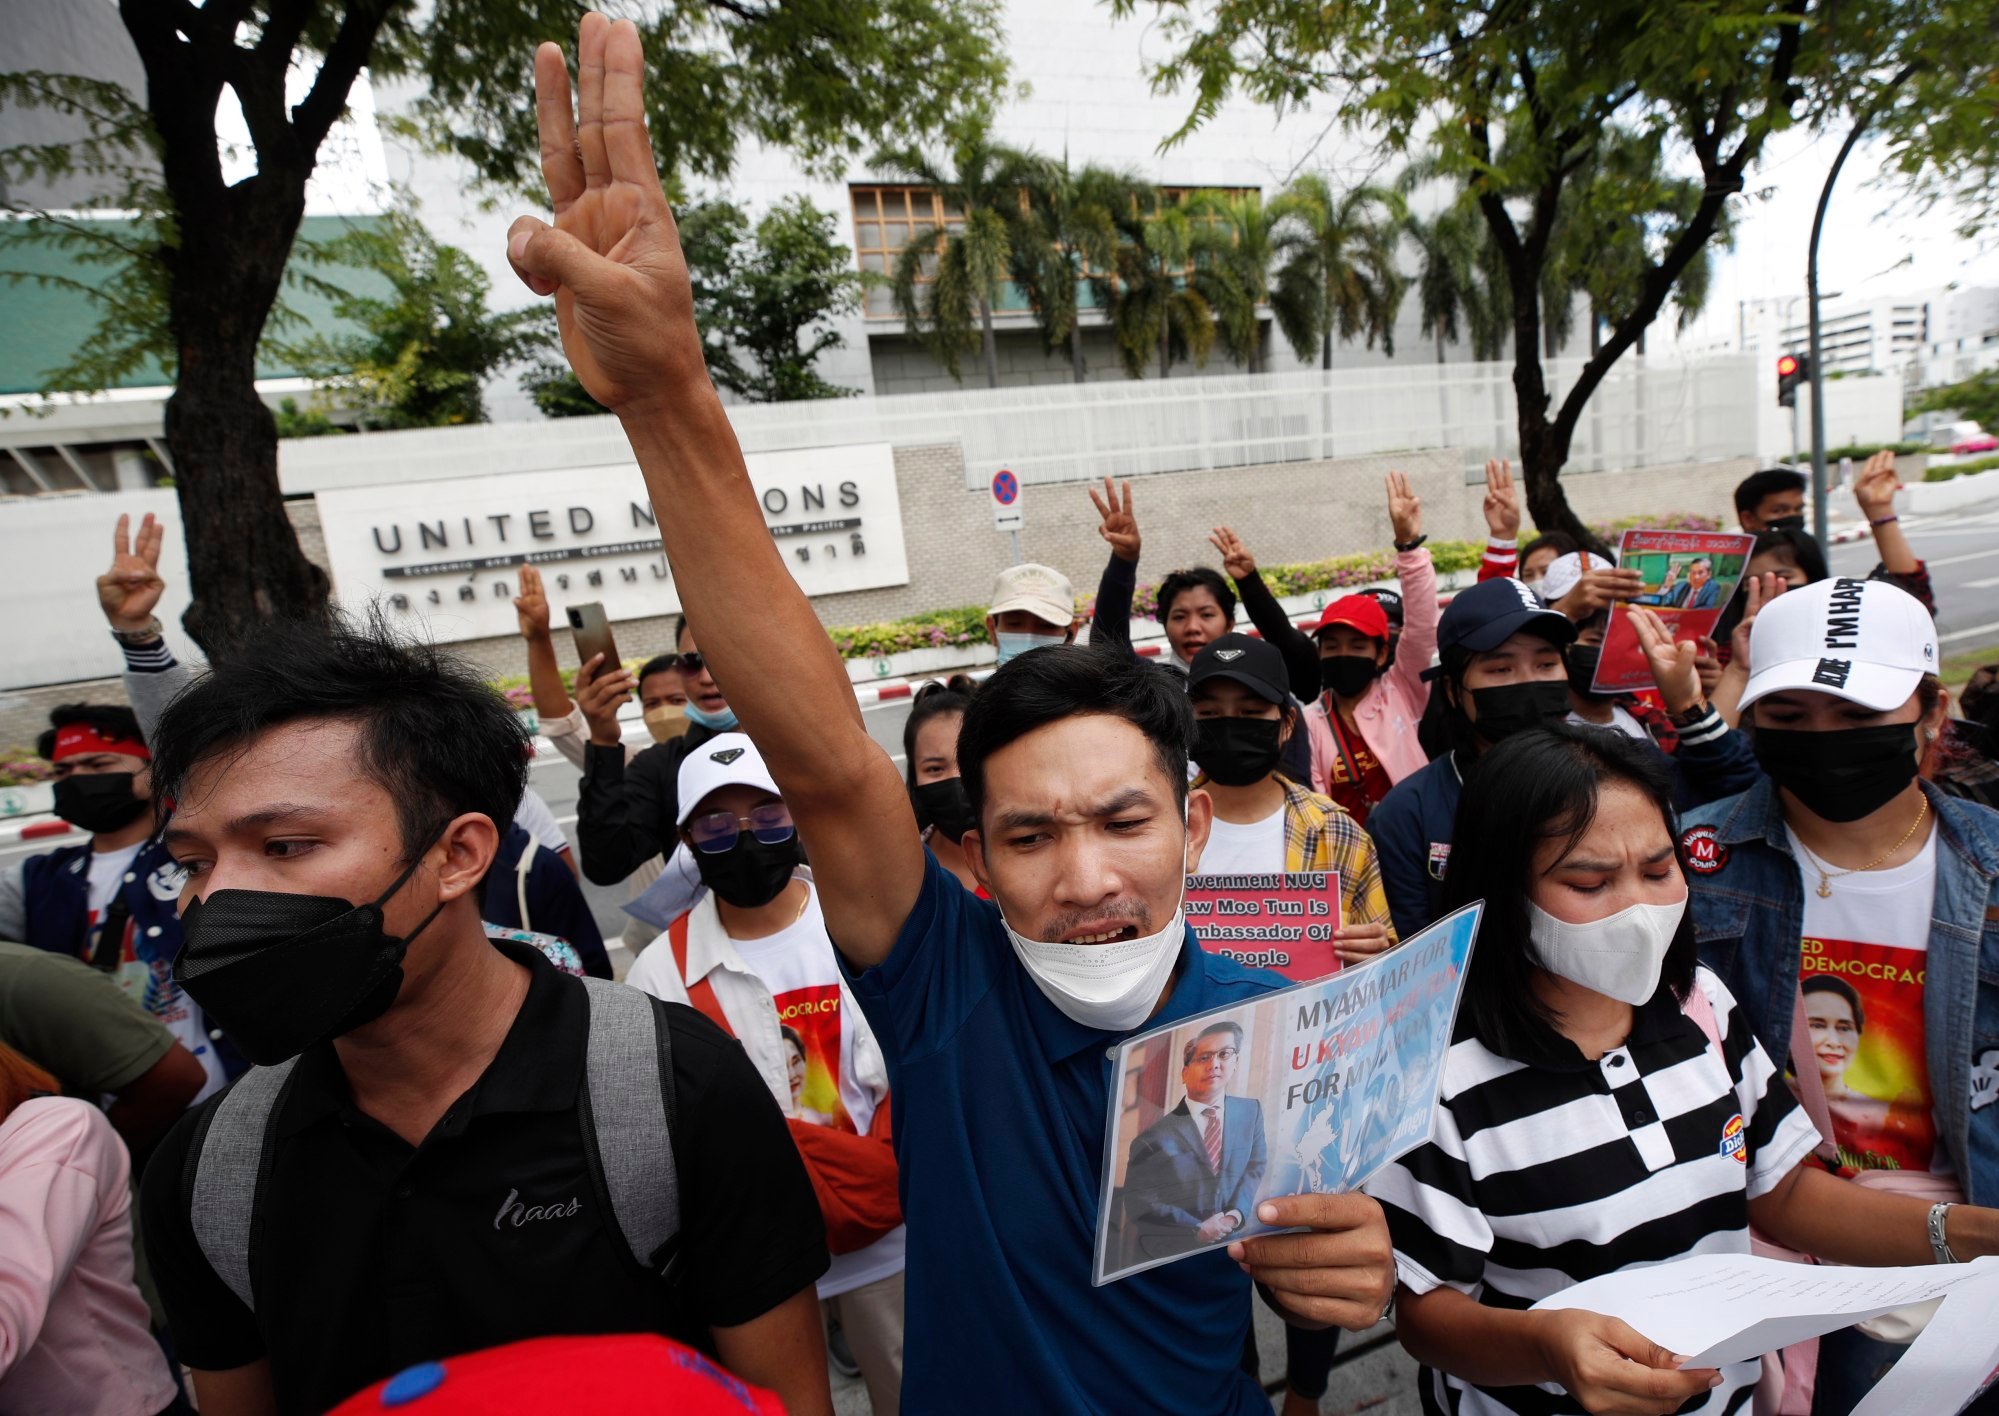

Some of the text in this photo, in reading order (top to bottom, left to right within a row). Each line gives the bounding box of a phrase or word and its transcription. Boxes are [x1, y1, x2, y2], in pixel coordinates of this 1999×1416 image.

[372, 481, 860, 554] UNITED NONS
[403, 560, 475, 577] Economic
[485, 555, 512, 567] and
[524, 549, 569, 563] Social
[772, 526, 795, 537] the
[802, 520, 846, 533] Pacific
[1824, 617, 1859, 649] I'M
[1696, 841, 1714, 859] M
[1186, 873, 1327, 889] overnment NUG
[1185, 900, 1329, 915] aw Moe Tun Is
[1193, 923, 1332, 940] mbassador Of
[1220, 950, 1290, 967] People
[1297, 936, 1448, 1031] MYANMAR FOR
[778, 998, 839, 1020] MOCRACY
[1292, 1043, 1311, 1071] U
[1316, 1016, 1382, 1065] KYAW
[1286, 1072, 1341, 1110] FOR
